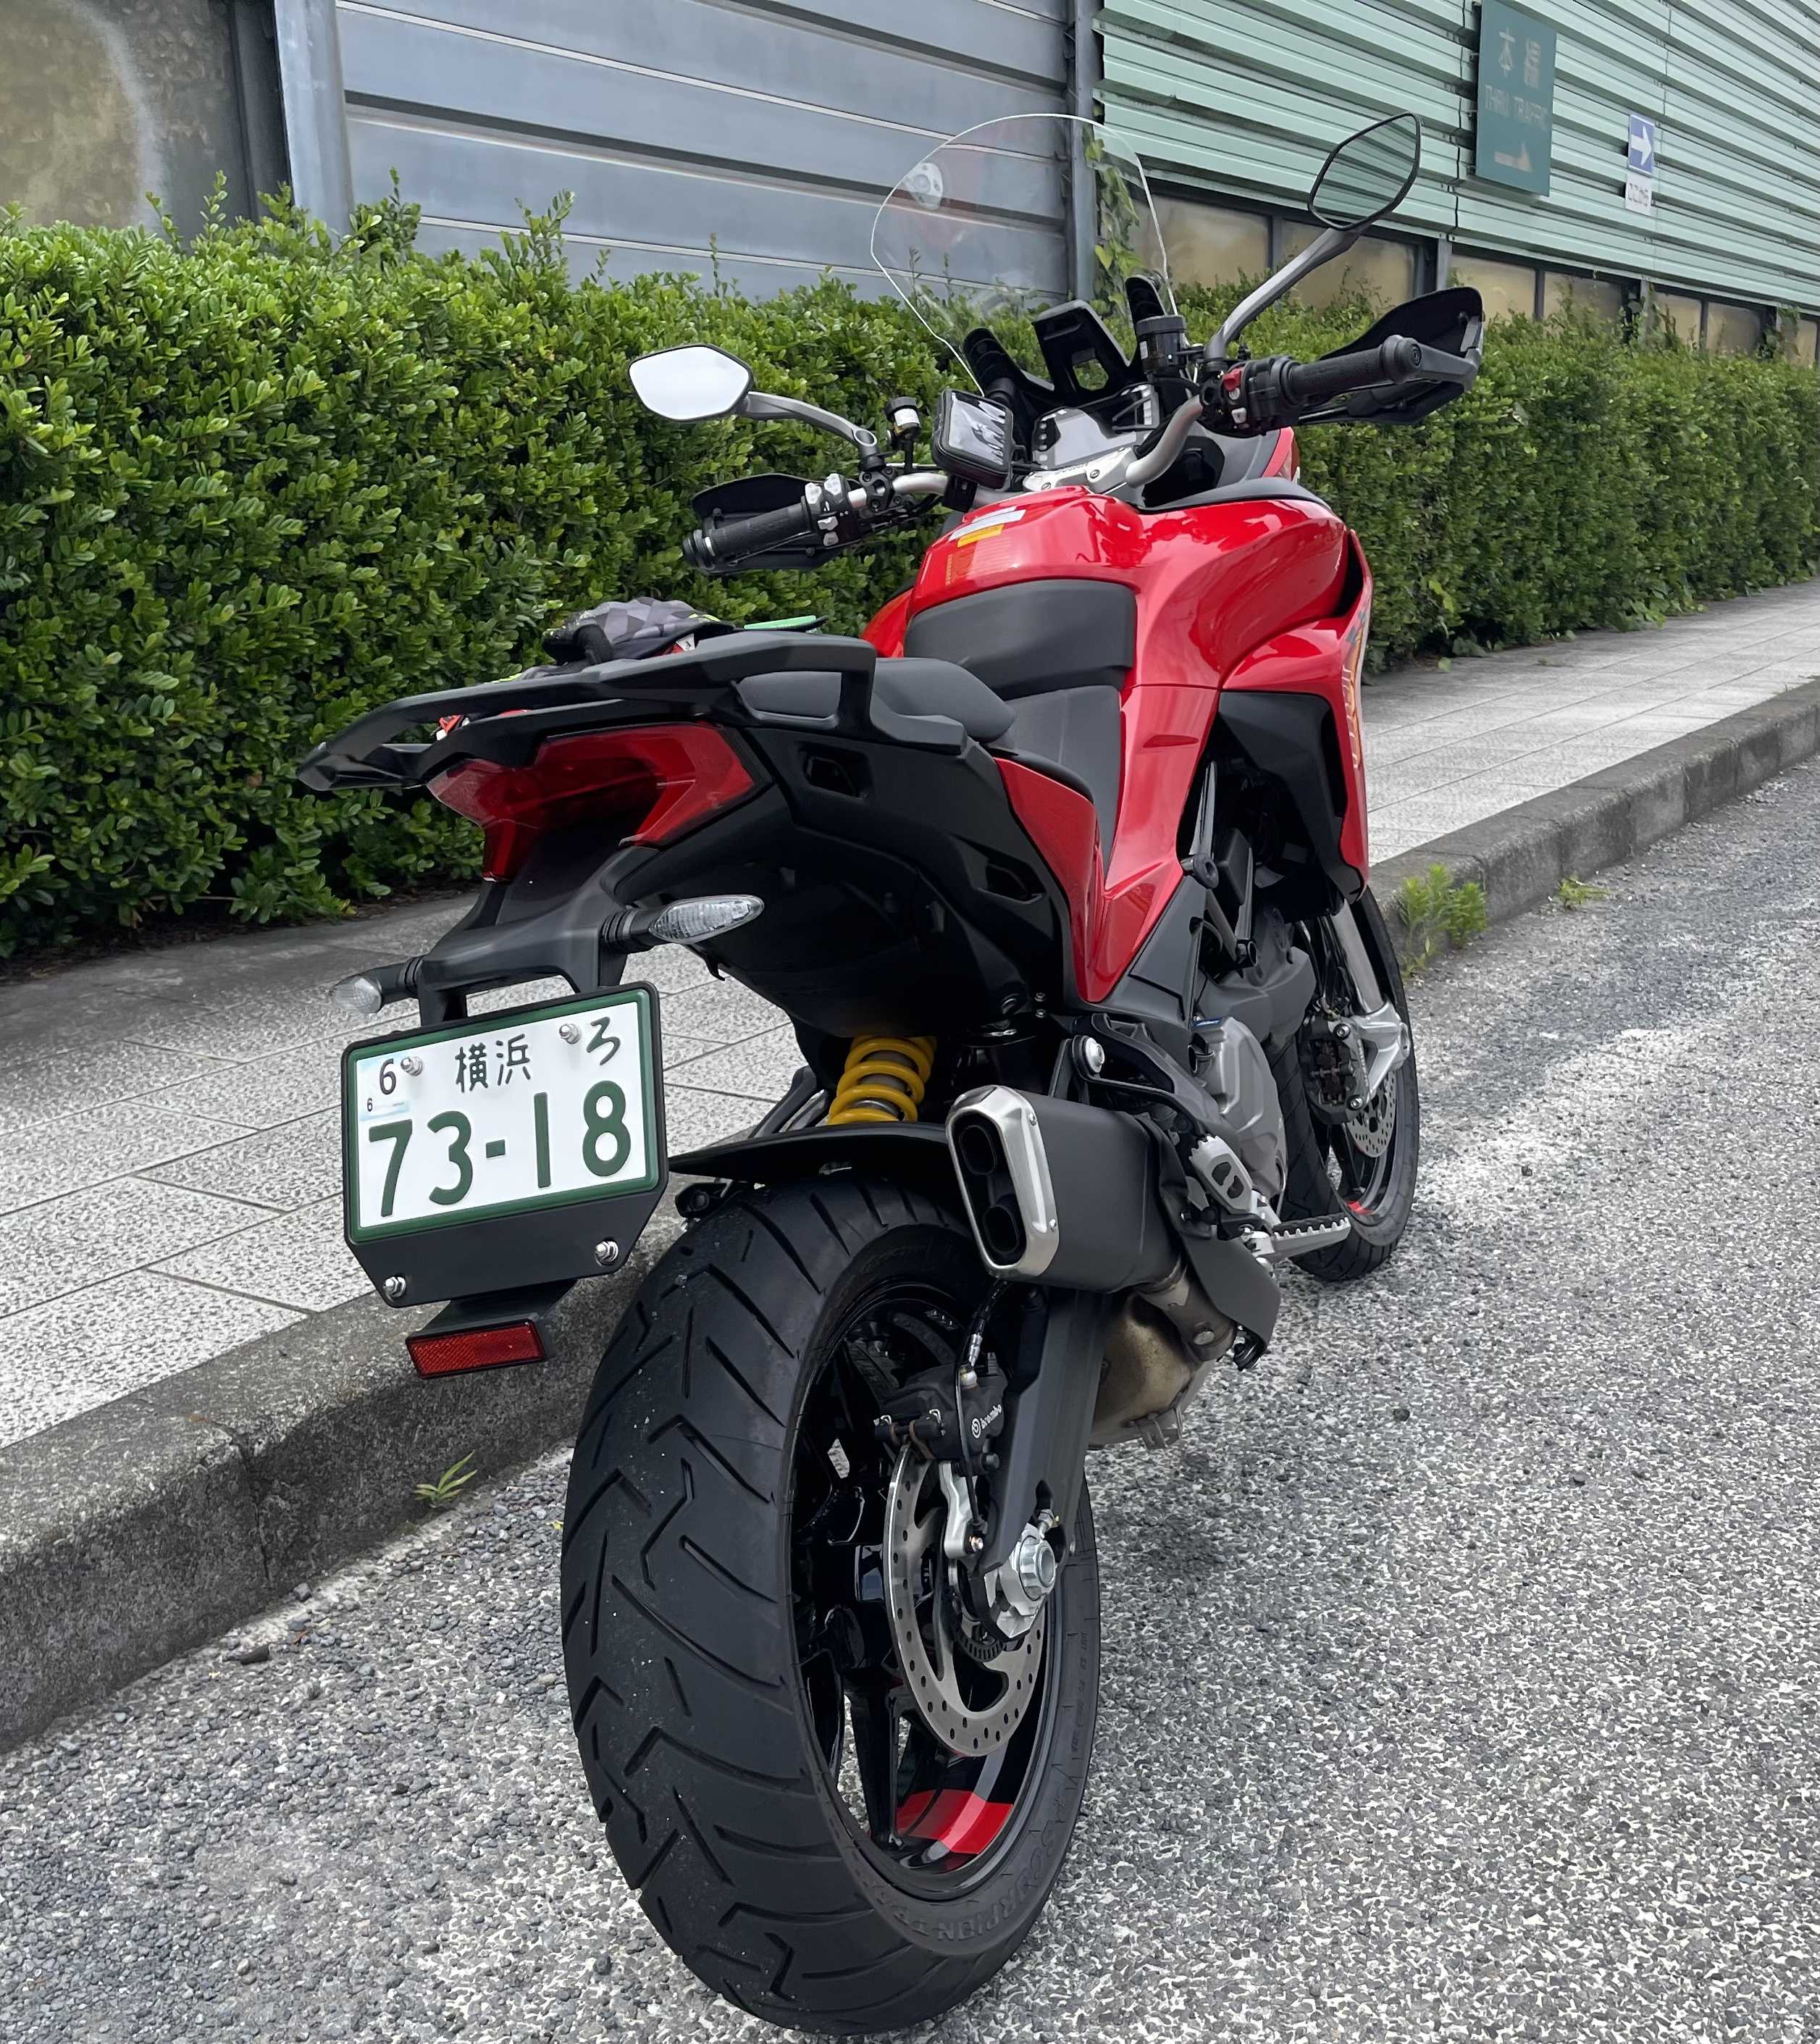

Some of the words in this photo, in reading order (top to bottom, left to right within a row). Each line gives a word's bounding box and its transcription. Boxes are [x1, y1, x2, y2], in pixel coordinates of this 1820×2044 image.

[379, 1058, 397, 1095] 6
[455, 1034, 530, 1092] 横浜
[586, 1016, 621, 1065] ろ
[366, 1097, 374, 1113] 6
[368, 1080, 632, 1218] 73-18
